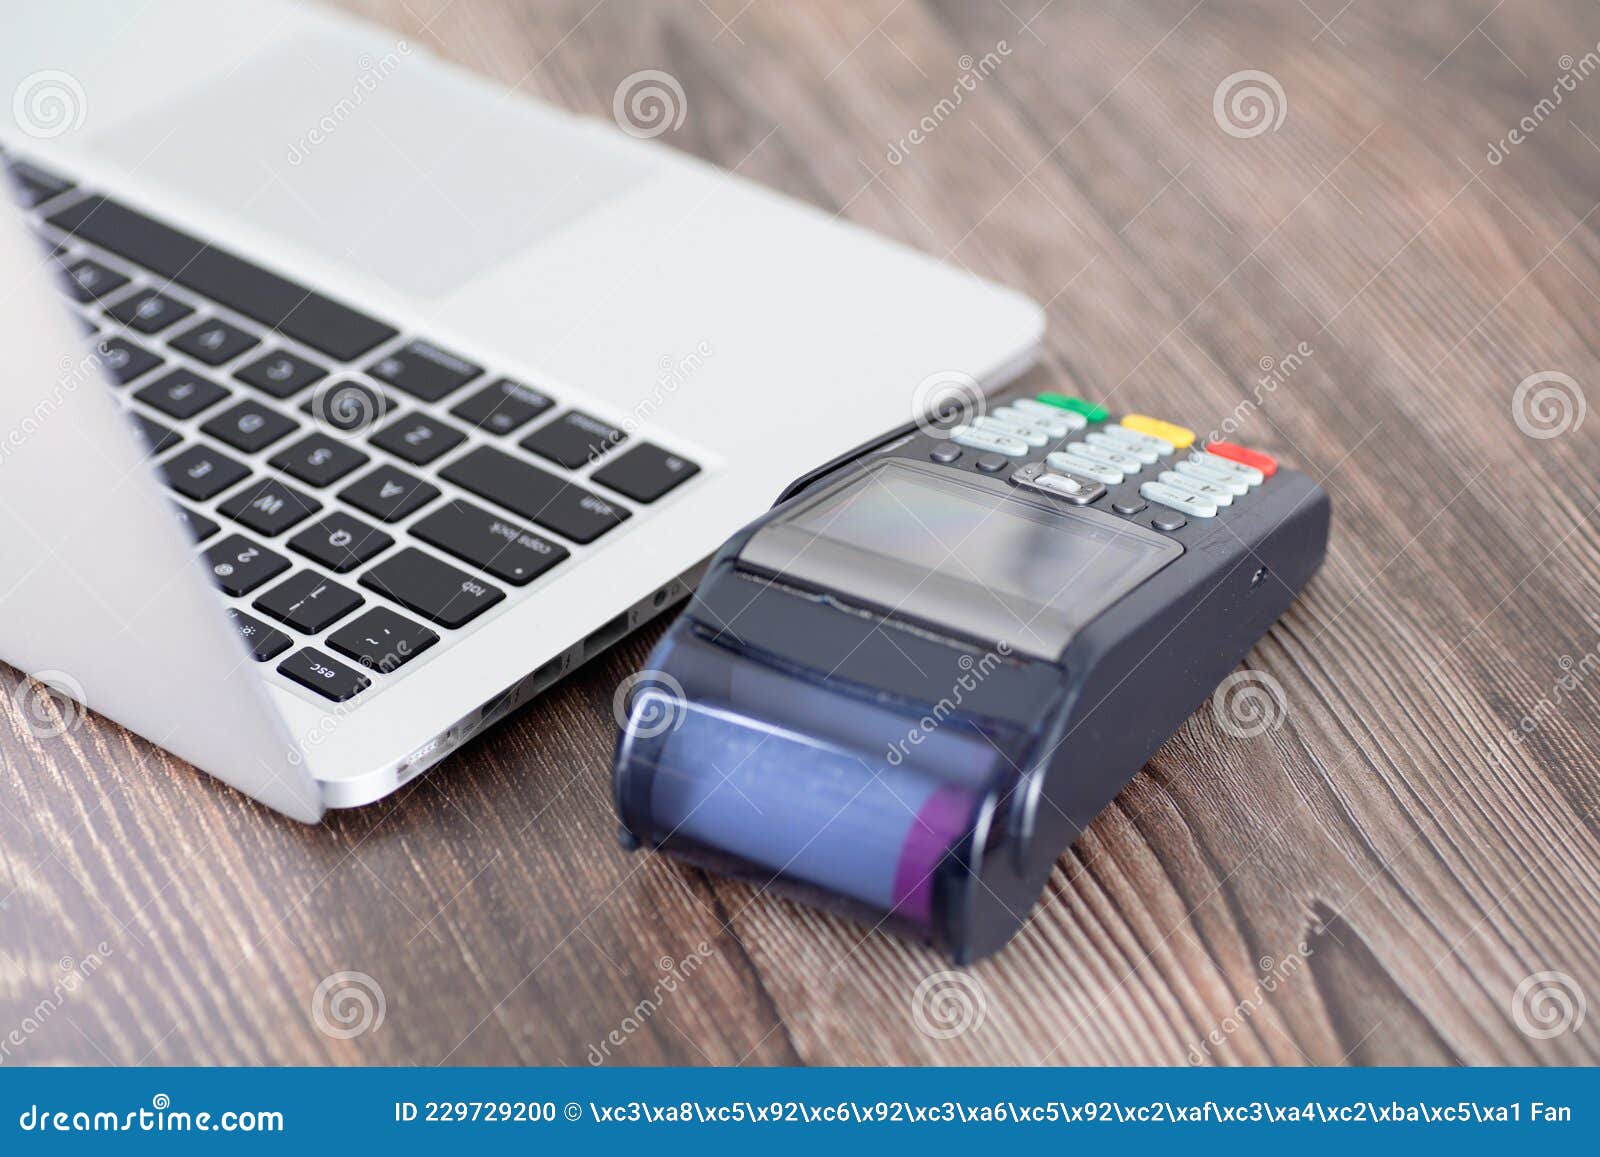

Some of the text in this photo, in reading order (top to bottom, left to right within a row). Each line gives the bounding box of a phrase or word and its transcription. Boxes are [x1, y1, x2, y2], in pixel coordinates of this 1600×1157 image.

[307, 448, 333, 466] S
[187, 460, 212, 479] E
[379, 480, 403, 498] A
[254, 494, 284, 515] W
[328, 529, 353, 548] Q
[237, 547, 260, 563] 2
[462, 580, 486, 597] tab
[309, 662, 336, 679] esc
